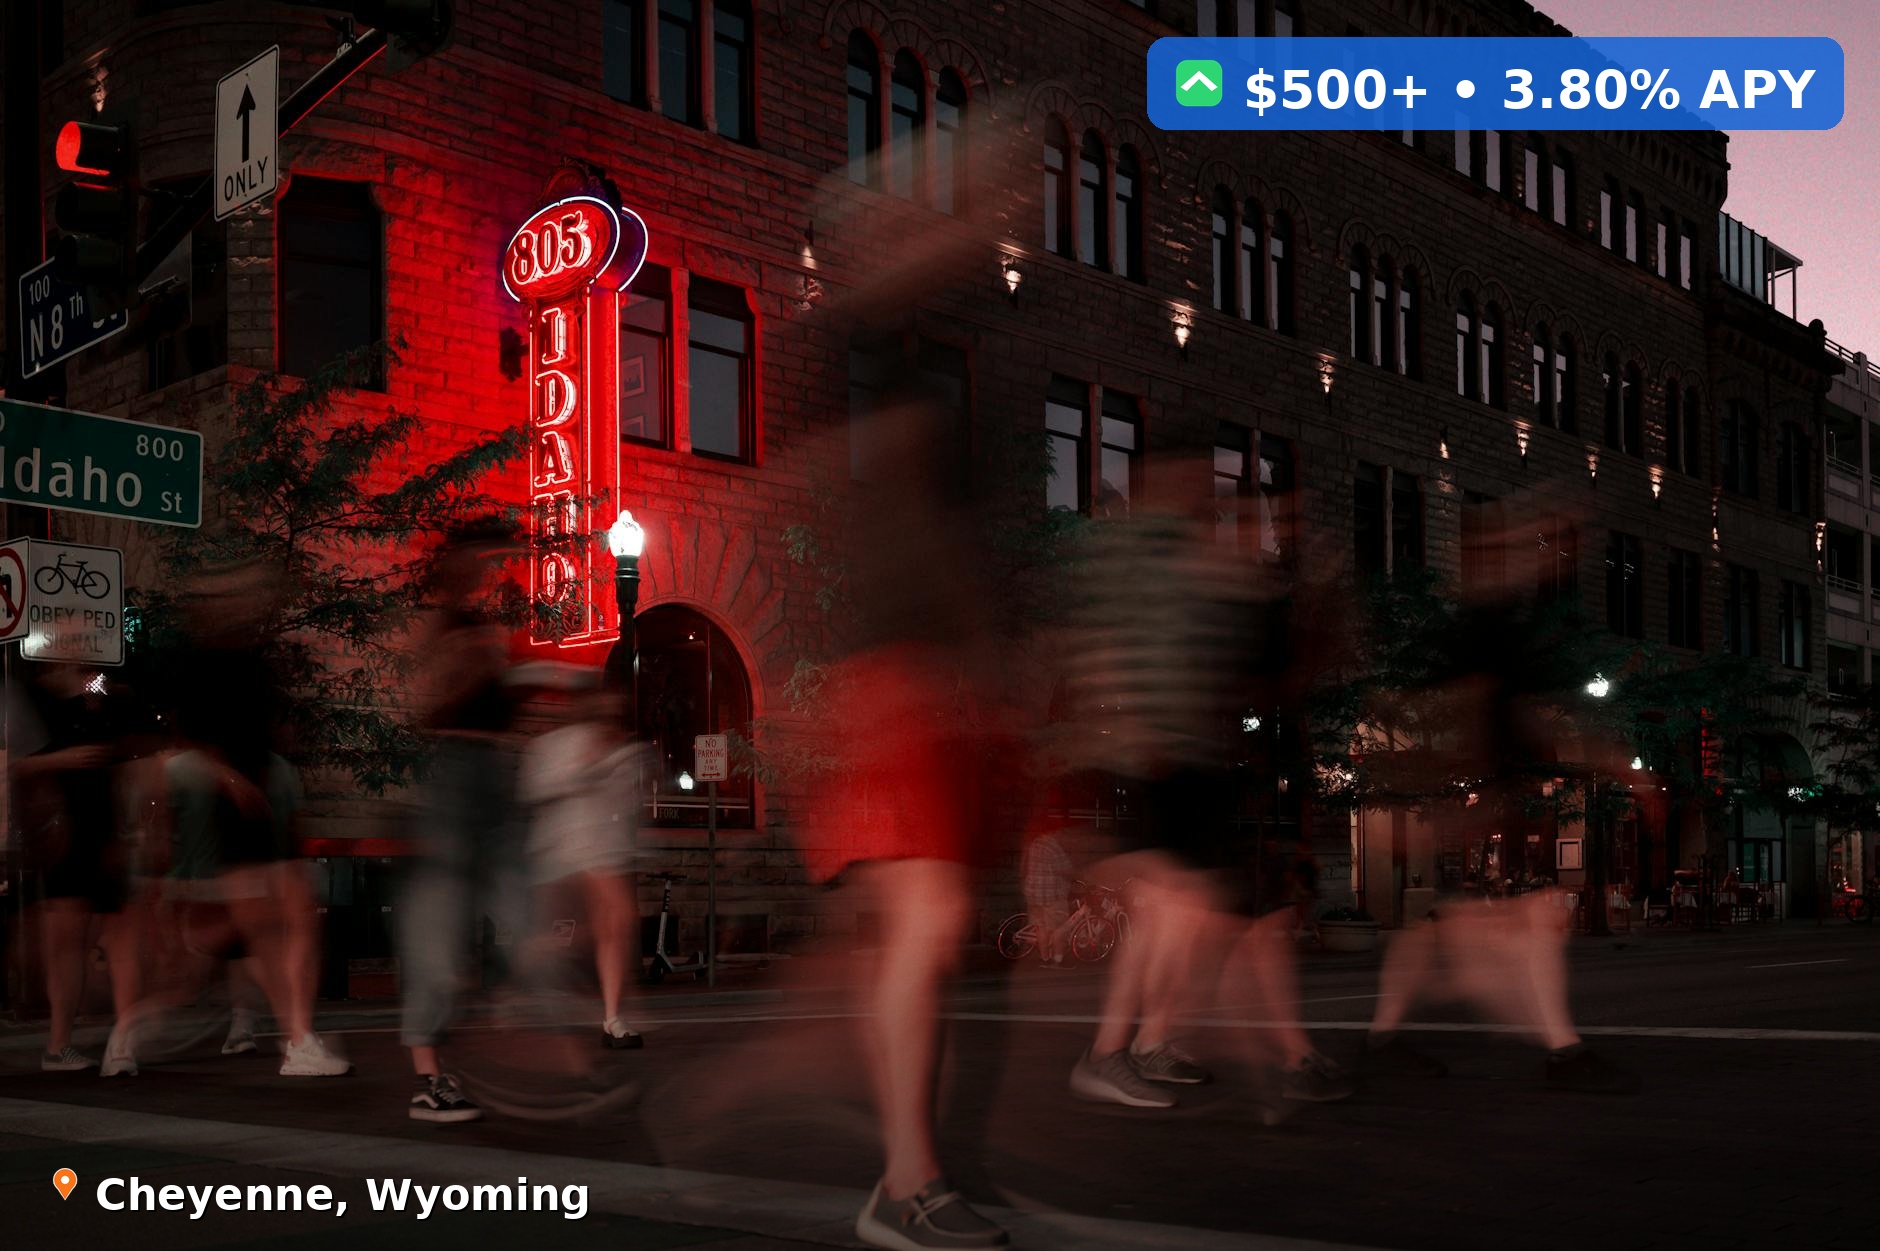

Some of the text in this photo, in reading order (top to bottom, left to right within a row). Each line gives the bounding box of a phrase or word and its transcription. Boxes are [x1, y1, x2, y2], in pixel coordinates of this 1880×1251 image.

[224, 156, 268, 202] ONLY
[511, 210, 592, 285] 805
[29, 274, 50, 306] 100
[30, 311, 45, 362] N
[135, 433, 184, 462] 800
[533, 306, 577, 606] IDAHO
[0, 446, 183, 514] Idaho St
[30, 604, 115, 629] OBEY PED
[43, 632, 103, 654] SIGNAL
[698, 748, 725, 759] PARKING
[705, 739, 717, 749] NO
[659, 807, 680, 820] FORK
